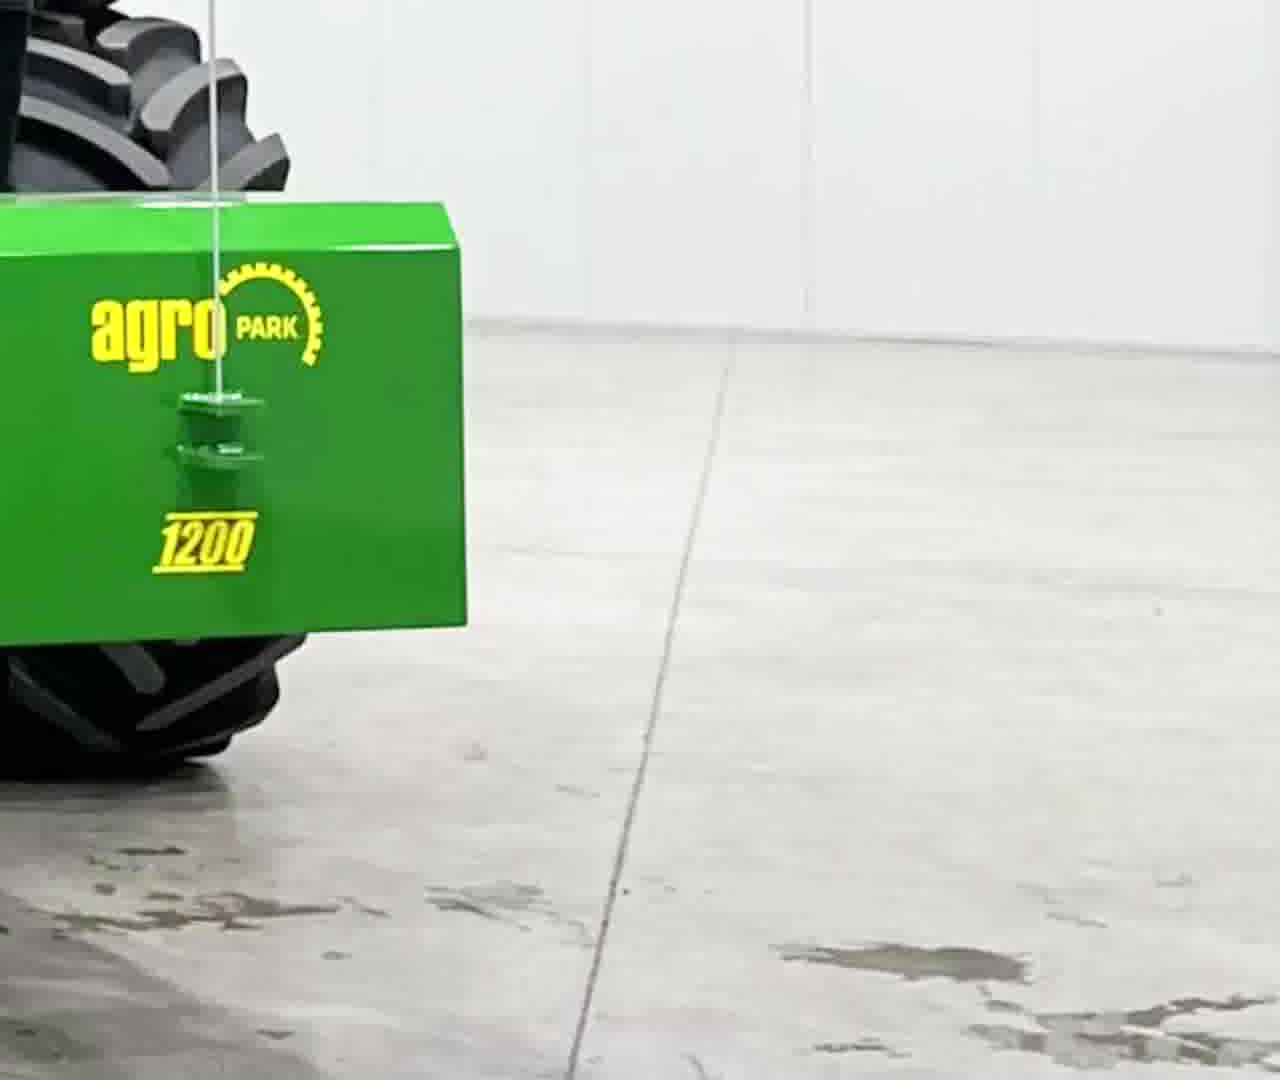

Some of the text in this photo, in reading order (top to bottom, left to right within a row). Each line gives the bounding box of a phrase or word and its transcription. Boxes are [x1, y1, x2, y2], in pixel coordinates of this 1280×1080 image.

[91, 299, 299, 373] agro PARK
[160, 520, 255, 567] 1200
